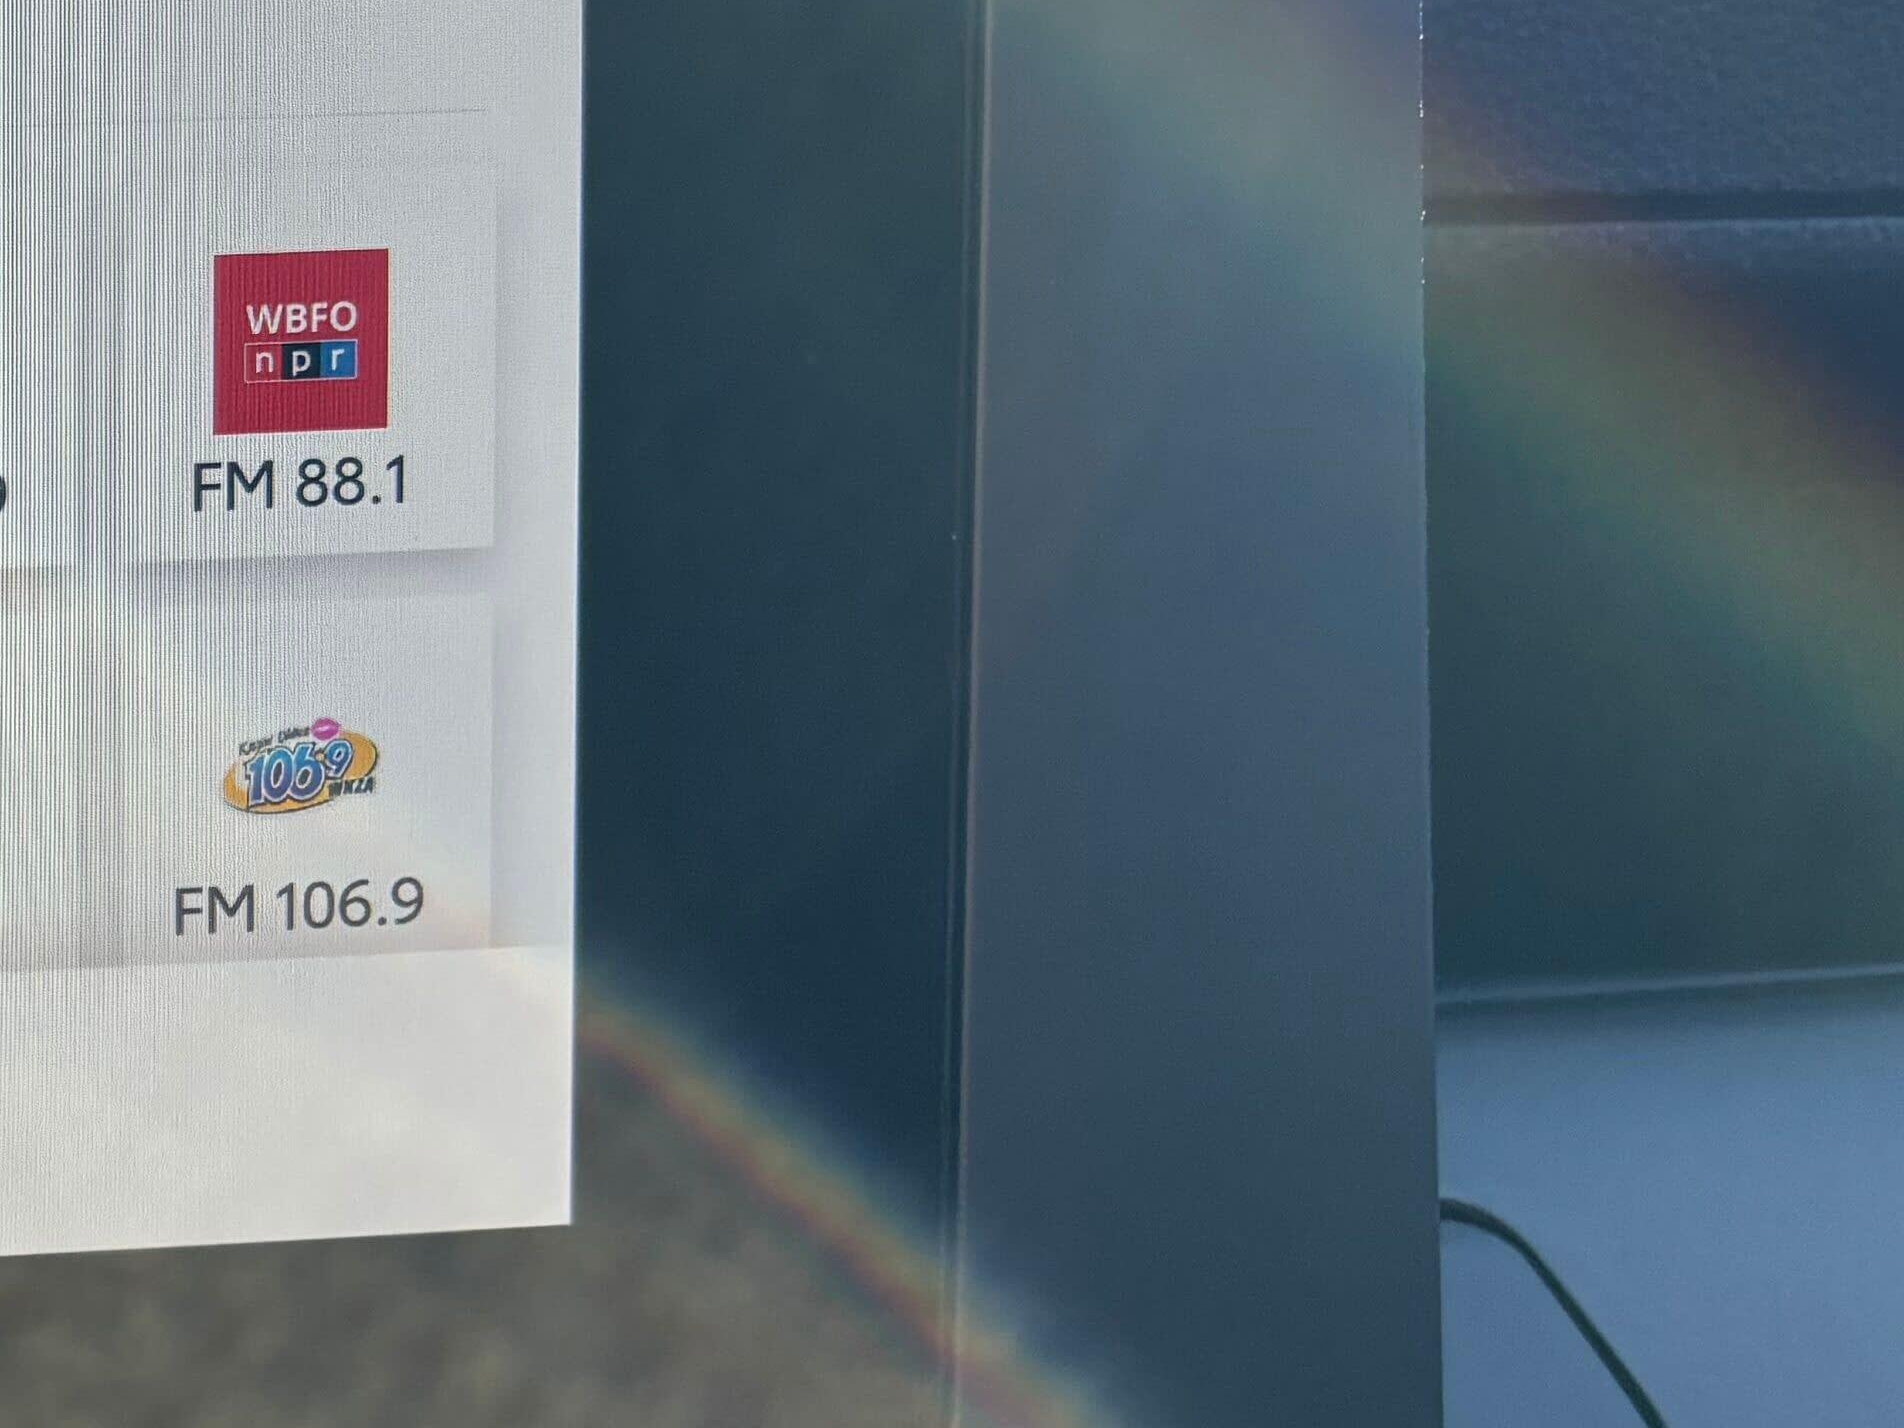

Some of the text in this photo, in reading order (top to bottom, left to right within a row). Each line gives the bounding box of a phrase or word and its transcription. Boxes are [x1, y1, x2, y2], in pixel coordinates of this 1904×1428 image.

[246, 301, 358, 335] WBFO
[255, 348, 345, 377] npr
[194, 454, 409, 513] FM 88.1
[249, 739, 354, 804] 106.9
[175, 877, 425, 936] FM 106.9
